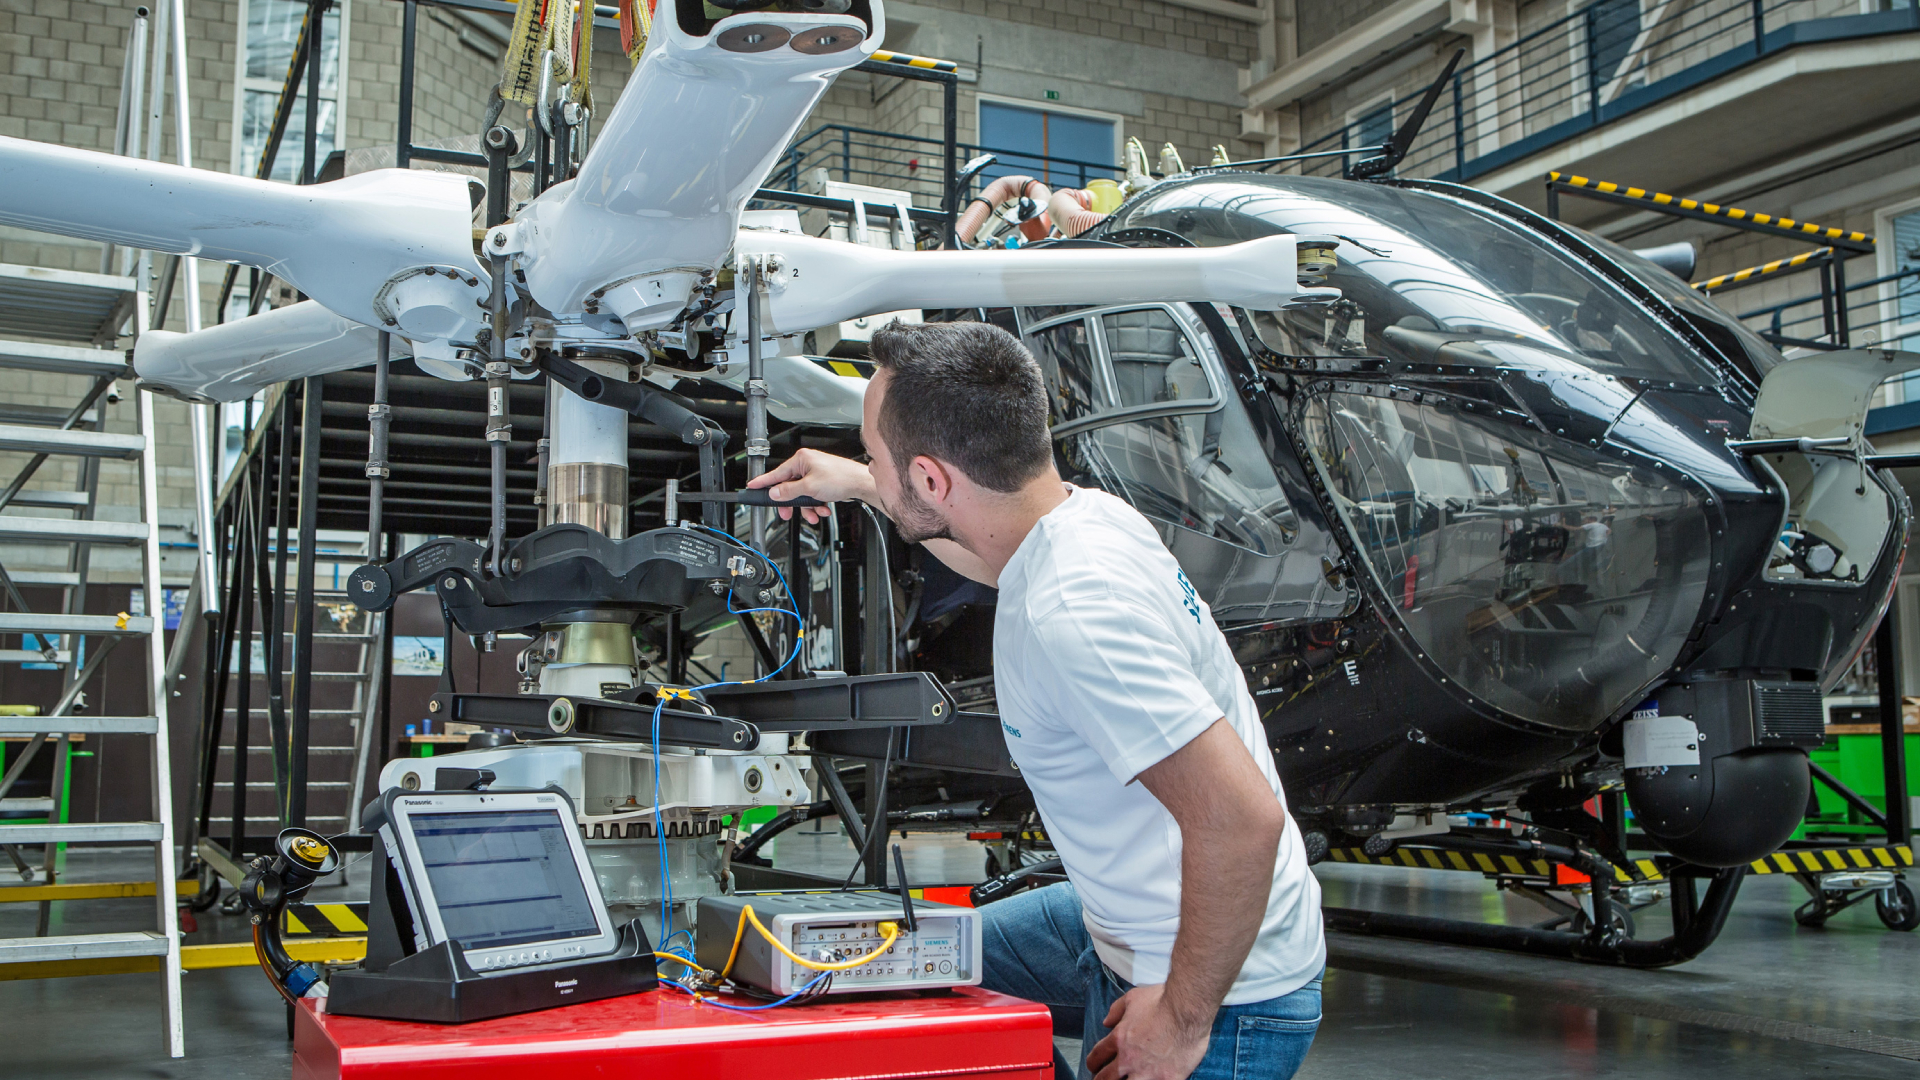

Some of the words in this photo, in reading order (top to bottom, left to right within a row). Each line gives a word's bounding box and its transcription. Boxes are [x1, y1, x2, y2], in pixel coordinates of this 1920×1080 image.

[792, 268, 799, 278] 2
[1633, 709, 1659, 720] ZEISS
[555, 979, 578, 989] Panasonic
